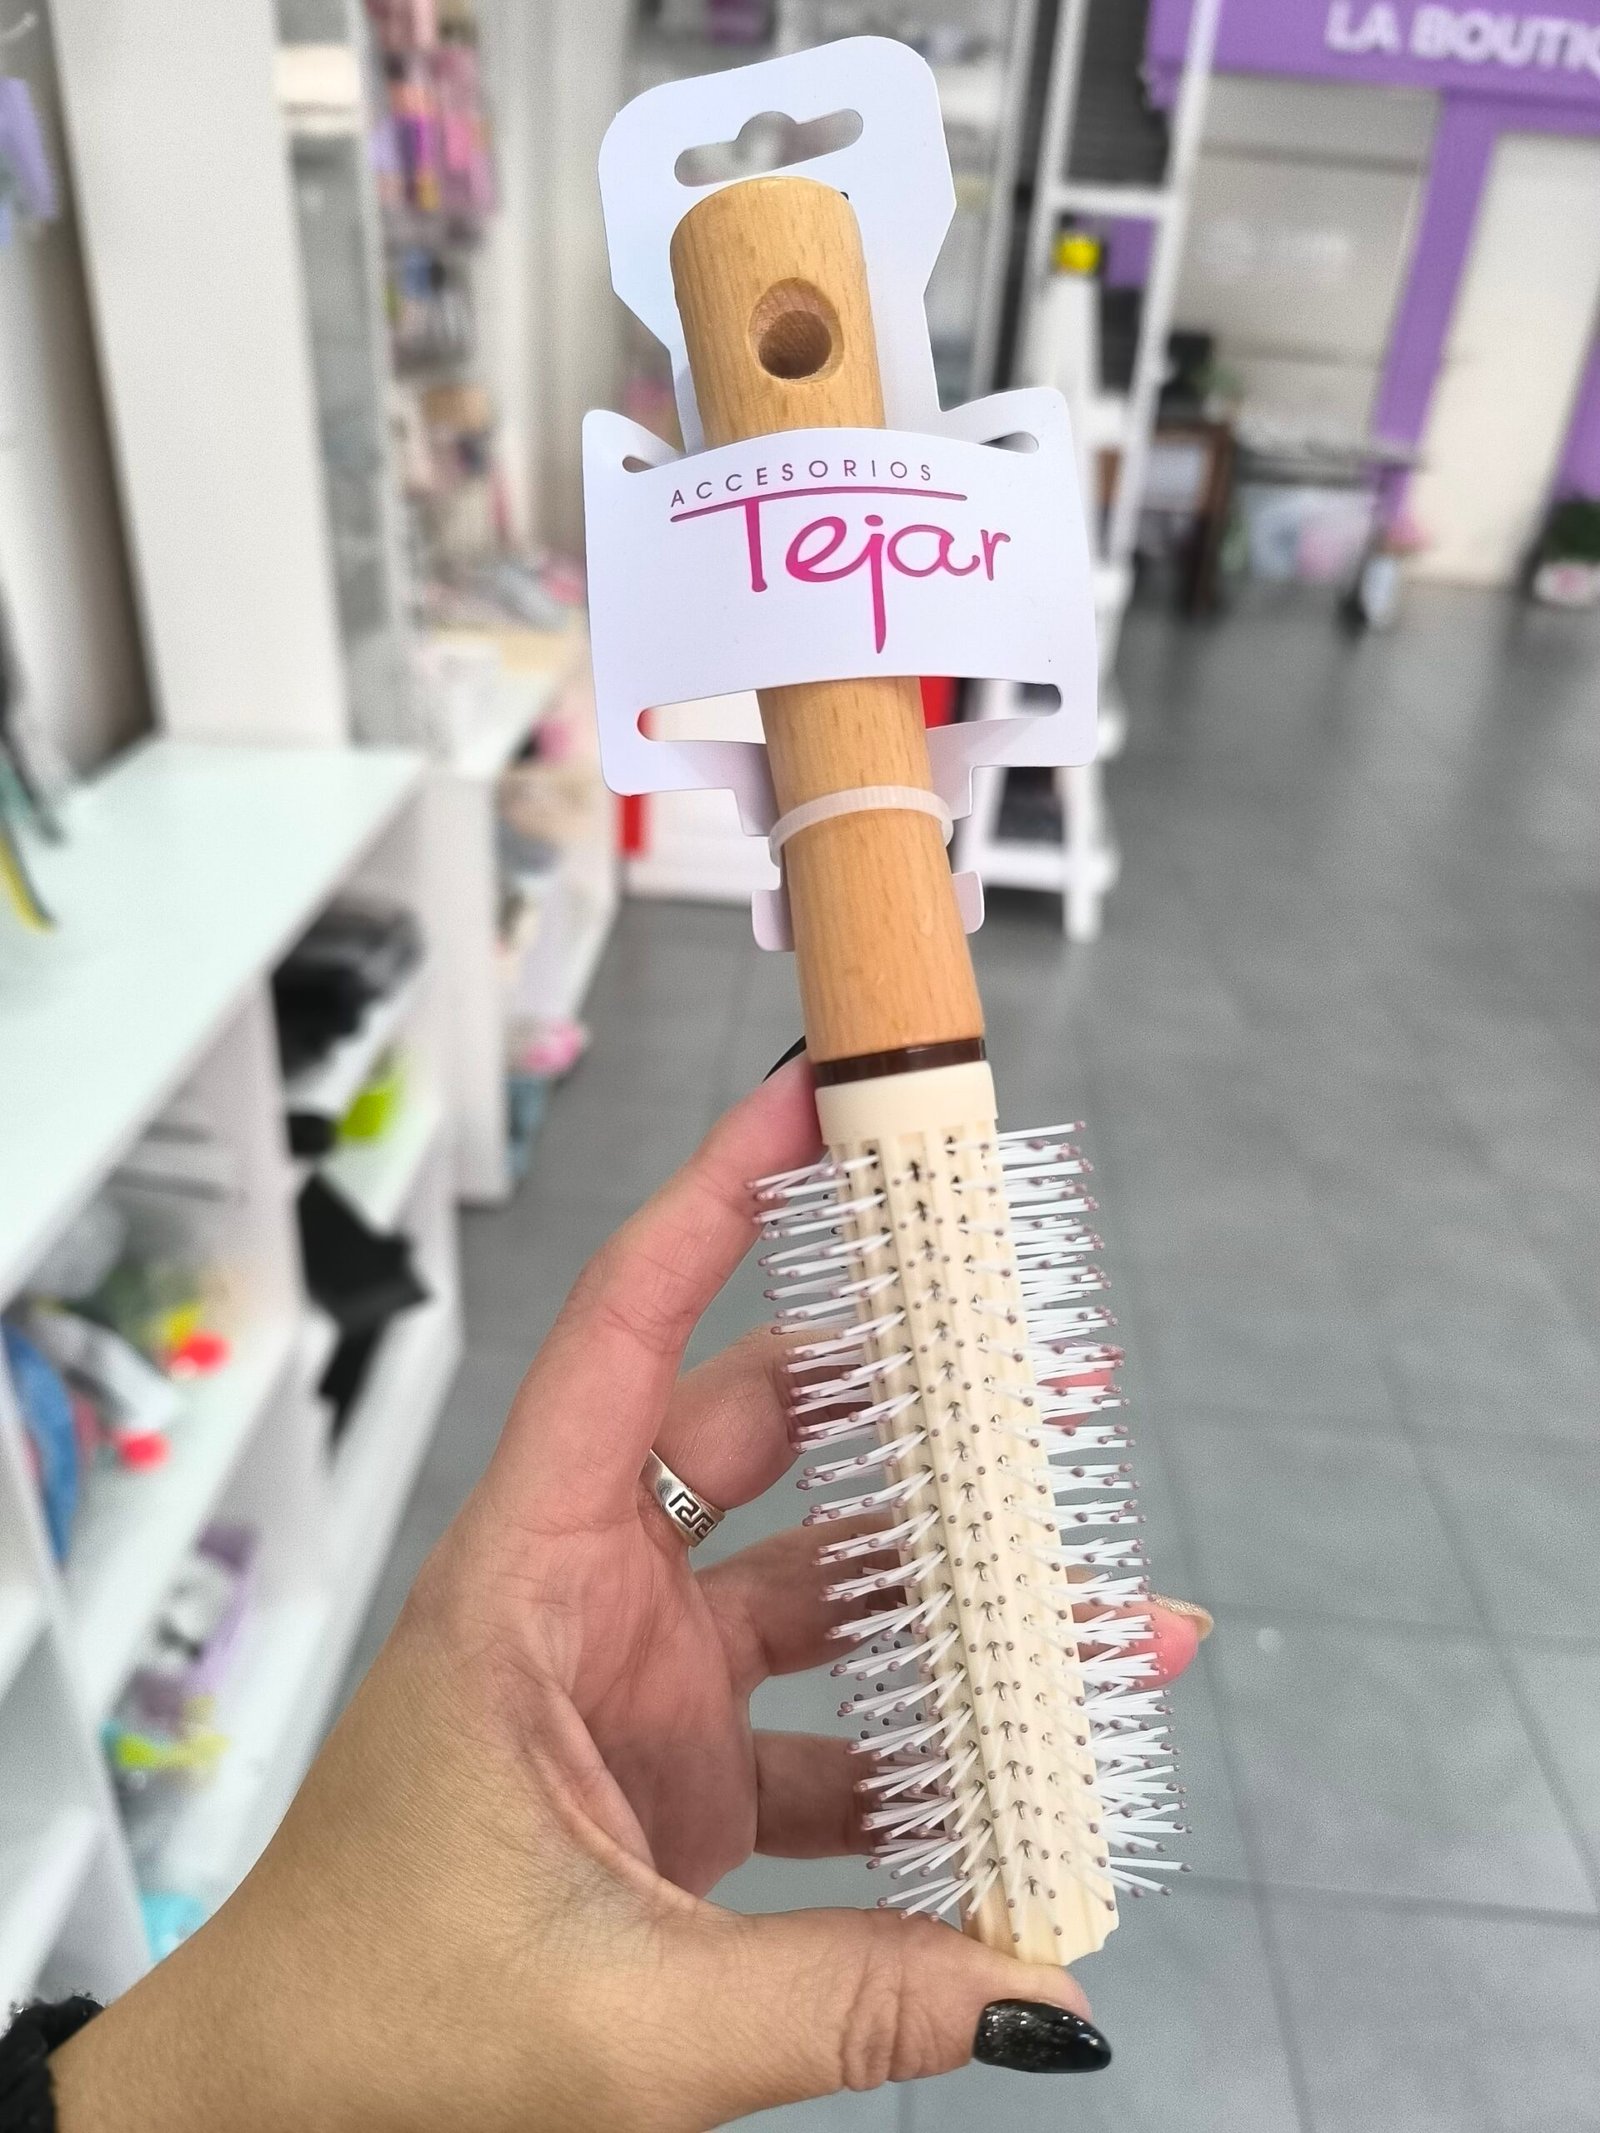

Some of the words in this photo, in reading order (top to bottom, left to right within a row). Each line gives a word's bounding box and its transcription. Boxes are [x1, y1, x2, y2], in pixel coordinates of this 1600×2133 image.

[1325, 0, 1398, 51] LA
[670, 459, 932, 507] ACCESORIOS
[671, 486, 1011, 654] Tejar
